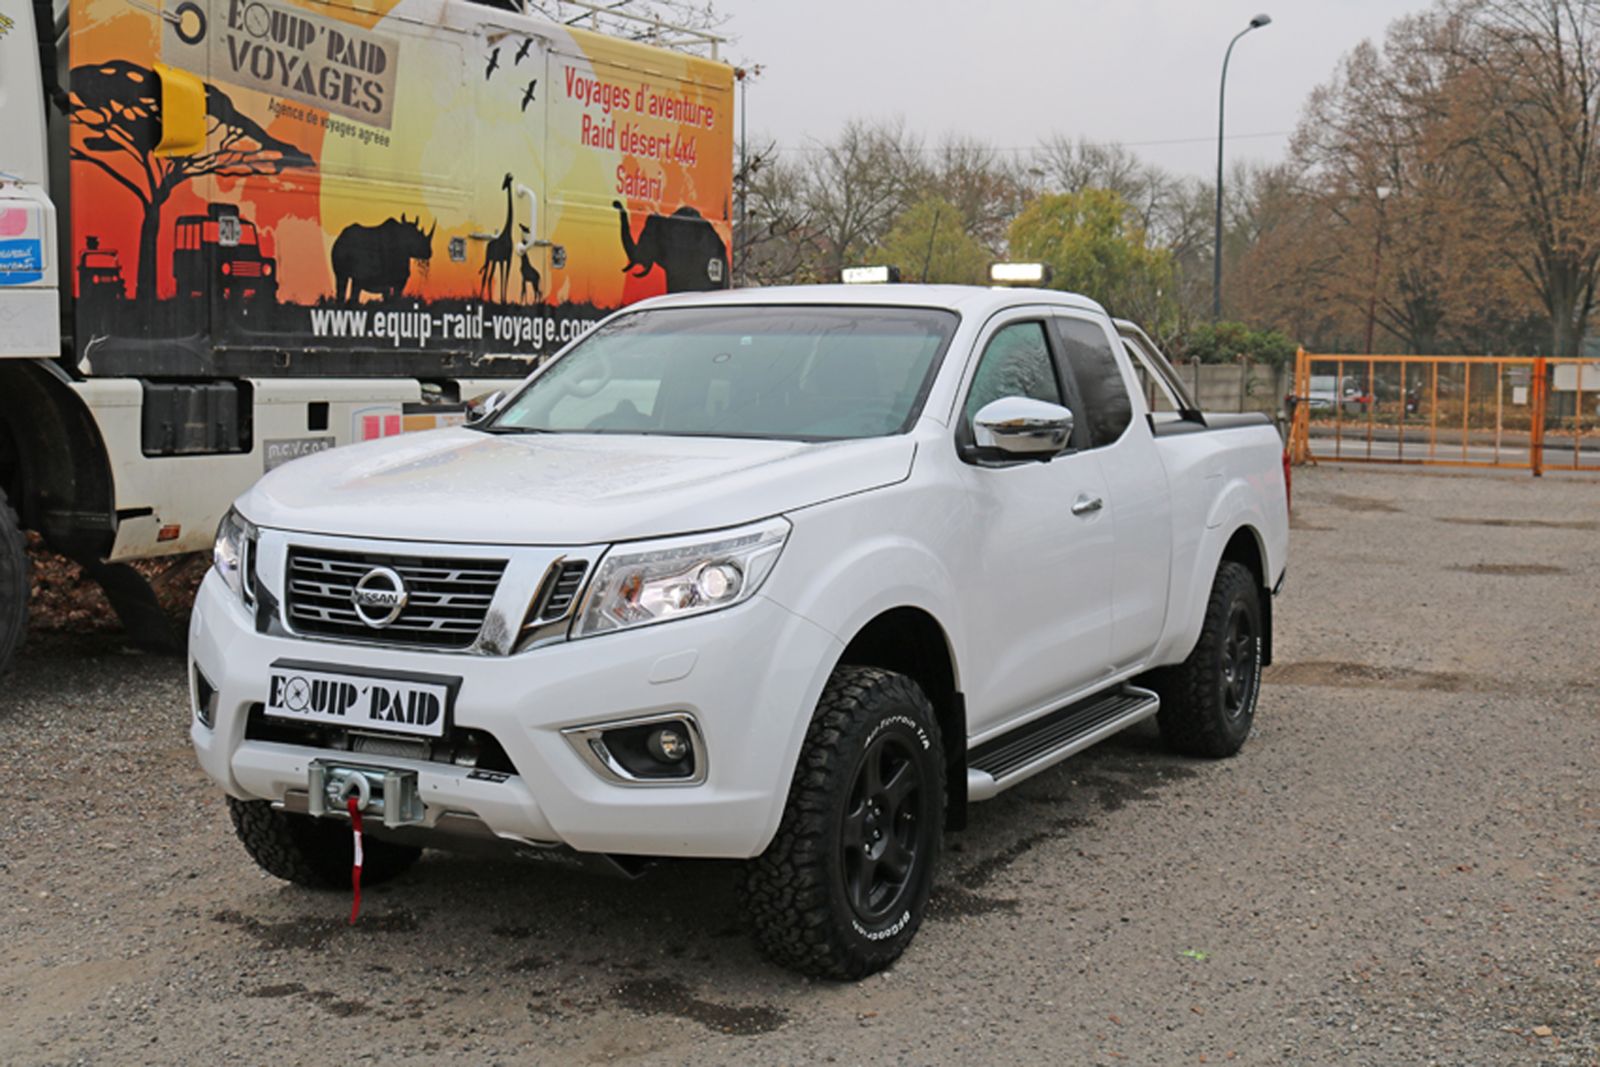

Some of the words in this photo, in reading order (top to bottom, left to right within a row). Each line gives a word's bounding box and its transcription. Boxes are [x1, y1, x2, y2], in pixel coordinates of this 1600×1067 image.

[227, 35, 385, 115] VOYAGES
[565, 65, 631, 114] Voyages
[635, 83, 714, 127] d'aventure
[268, 97, 304, 121] Agence
[307, 110, 318, 126] de
[321, 117, 356, 138] voyages
[581, 113, 616, 150] Raid
[620, 122, 671, 161] désert
[674, 133, 696, 166] 4x4
[616, 164, 662, 200] Safari
[357, 591, 399, 605] NISSAN
[268, 674, 440, 727] EQUIP'RAID
